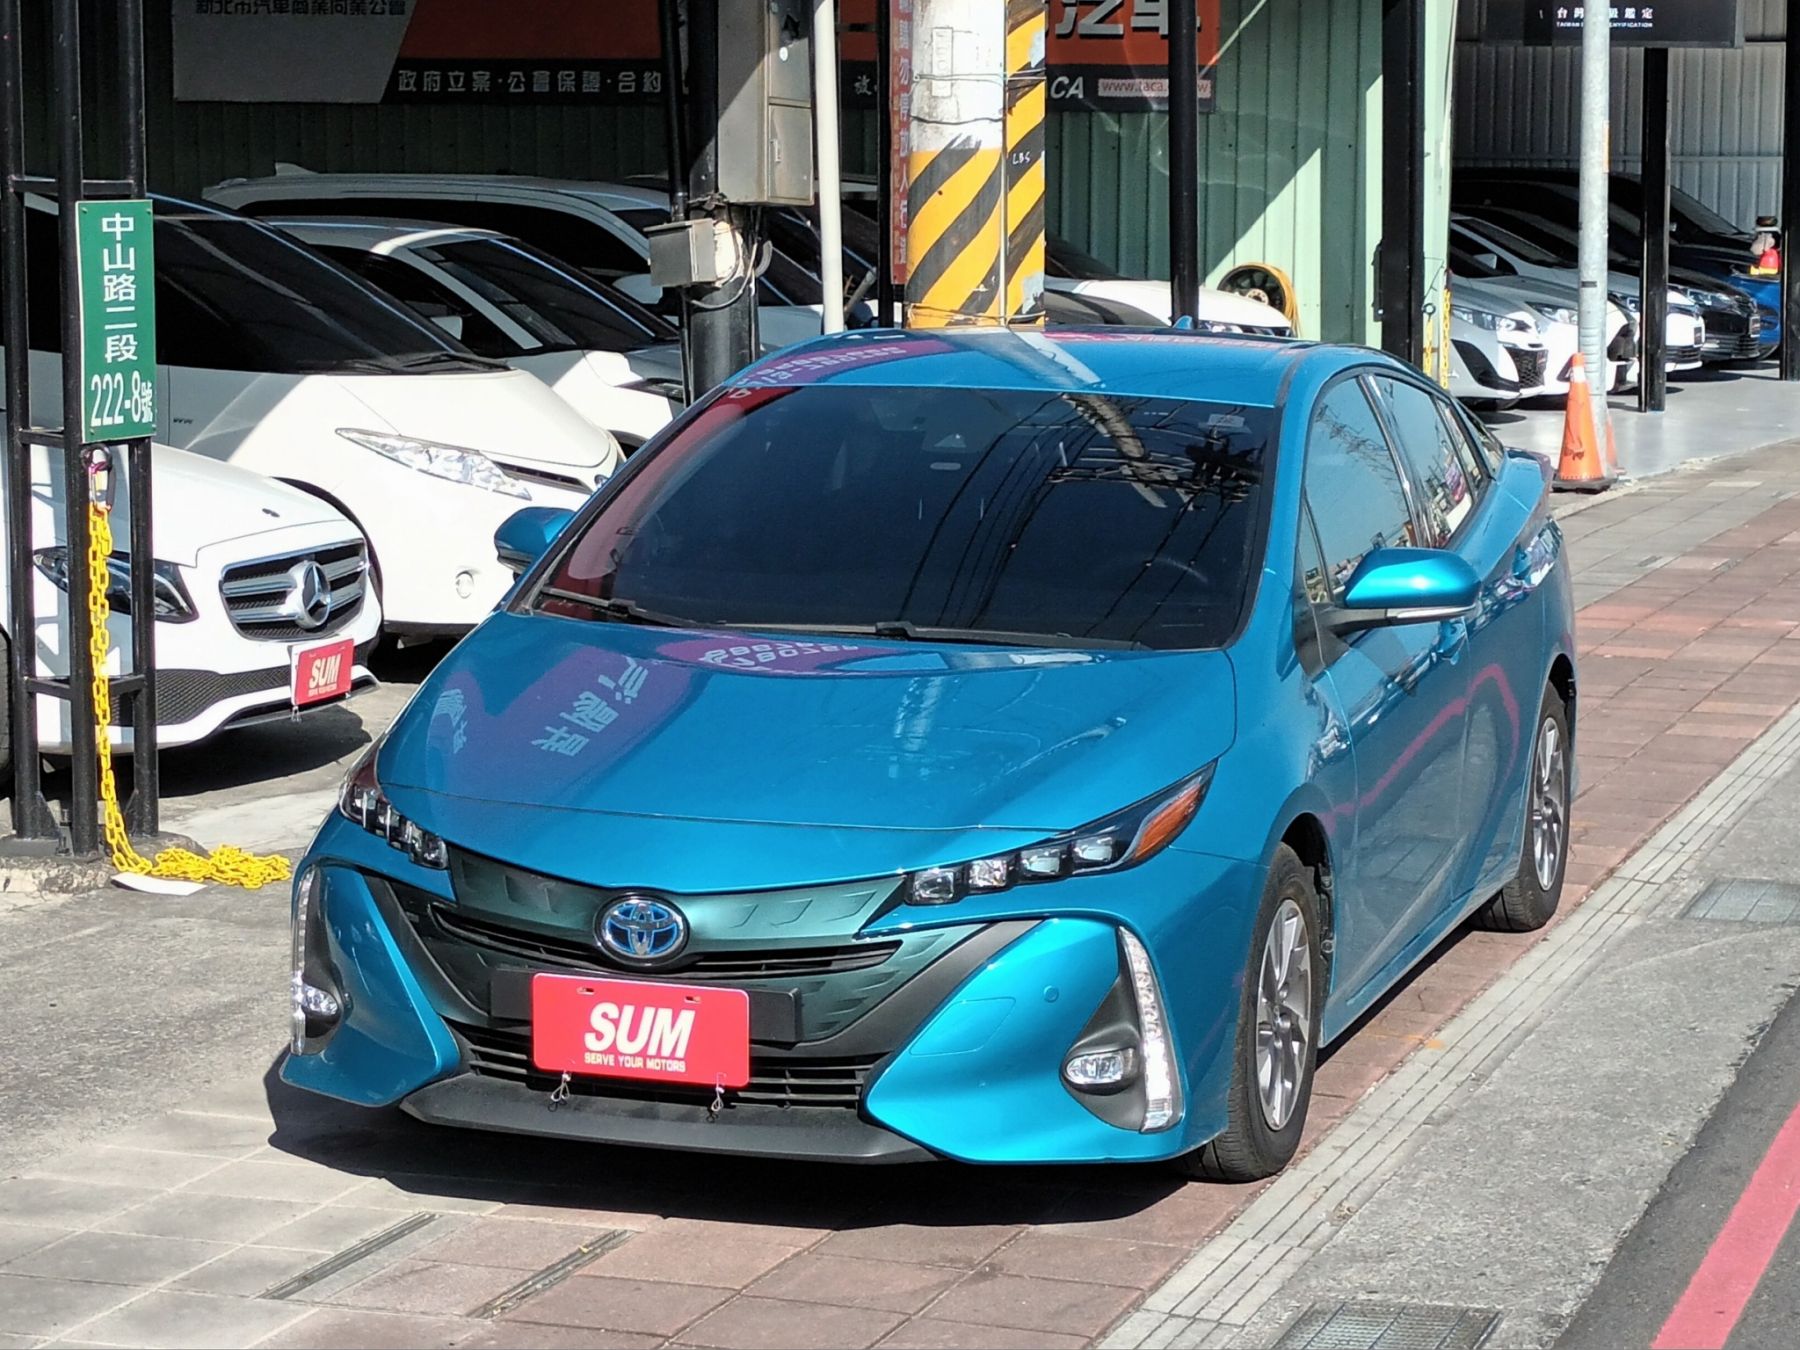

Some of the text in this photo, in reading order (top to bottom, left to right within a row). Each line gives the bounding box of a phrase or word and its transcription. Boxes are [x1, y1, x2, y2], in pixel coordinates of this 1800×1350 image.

[102, 212, 138, 363] 中山路二段
[309, 654, 341, 689] SUM
[584, 1002, 696, 1059] SUM
[584, 1052, 686, 1073] SERVE YOUR MOTORS
